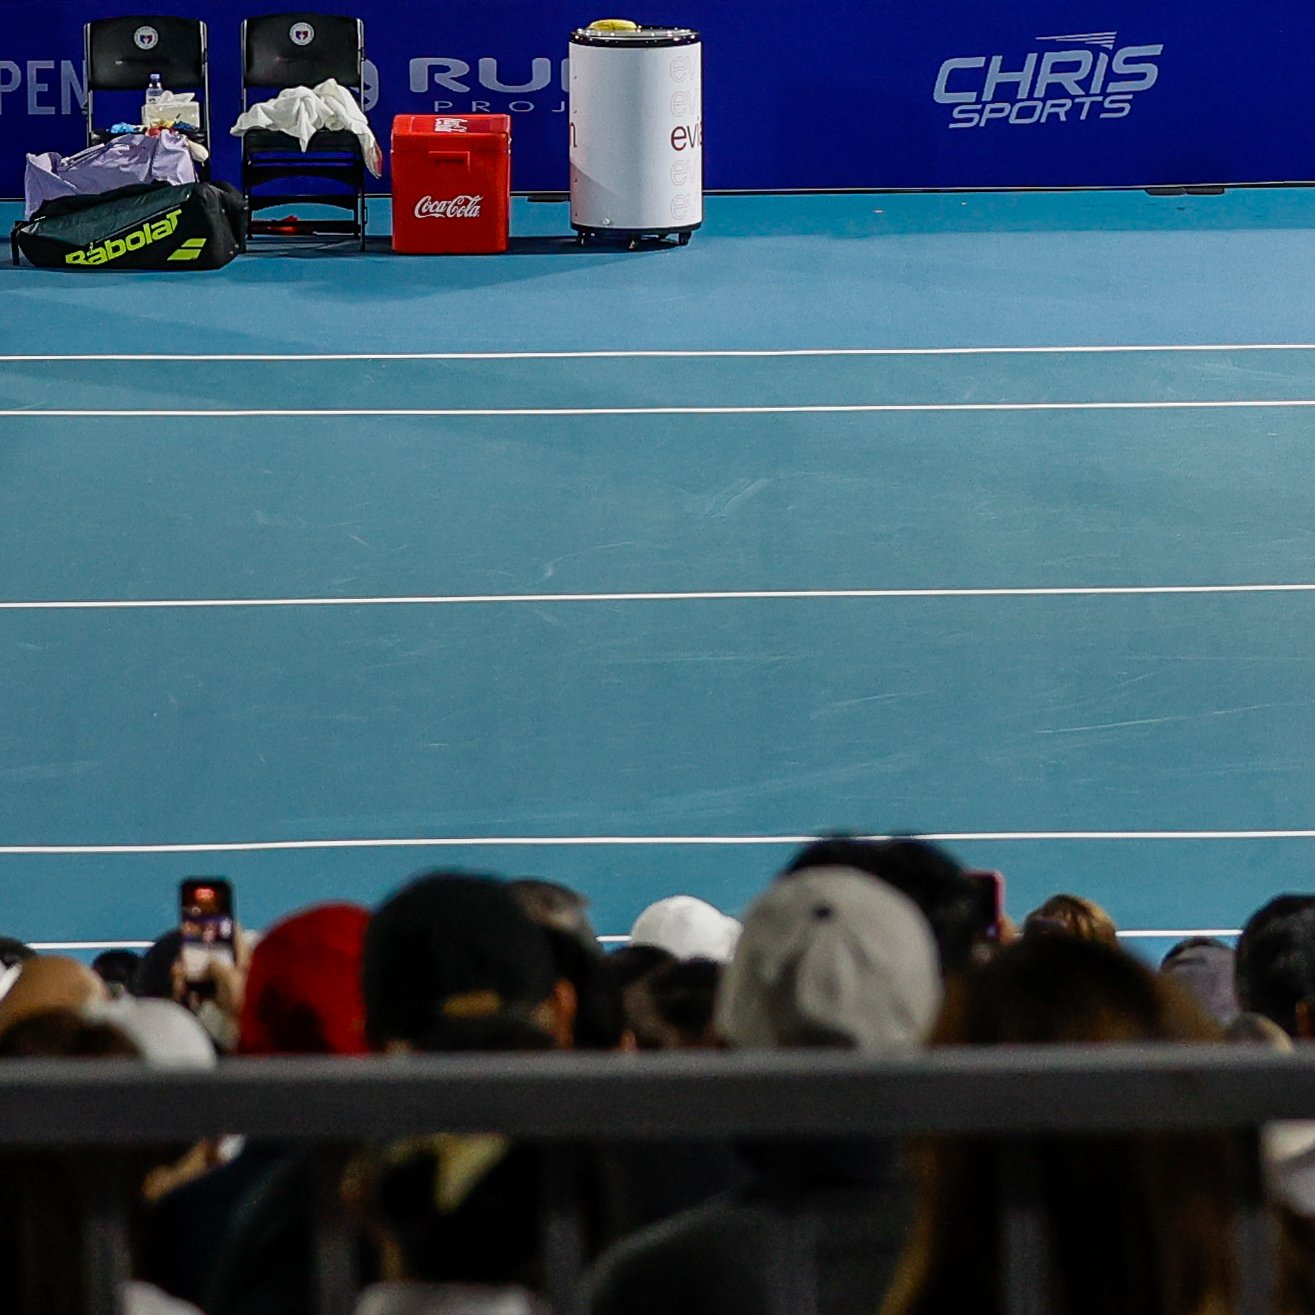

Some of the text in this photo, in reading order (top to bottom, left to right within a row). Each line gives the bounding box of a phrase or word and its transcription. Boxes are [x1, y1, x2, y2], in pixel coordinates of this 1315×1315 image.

[408, 58, 569, 93] RU
[933, 45, 1164, 104] CHRIS
[434, 101, 566, 113] PROJ
[949, 95, 1133, 128] SPORTS
[414, 195, 484, 219] Coca-Cola
